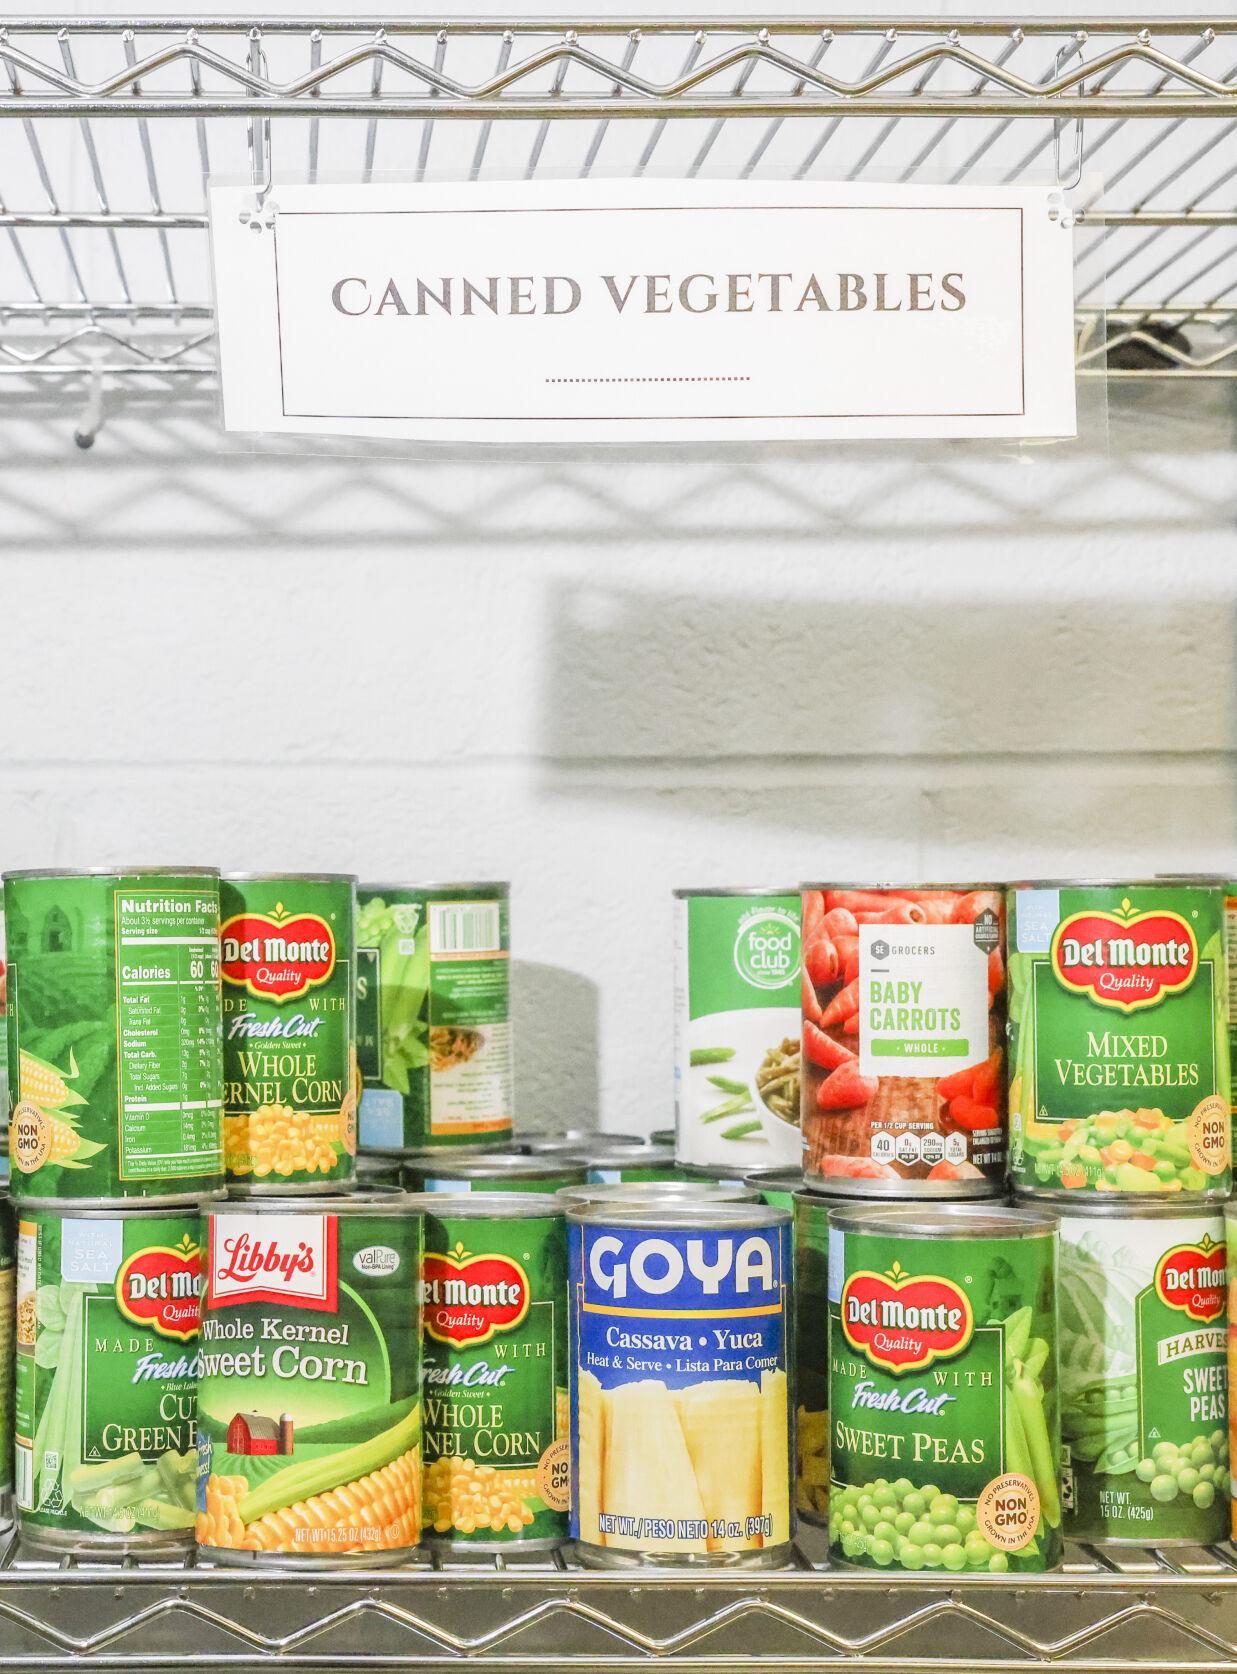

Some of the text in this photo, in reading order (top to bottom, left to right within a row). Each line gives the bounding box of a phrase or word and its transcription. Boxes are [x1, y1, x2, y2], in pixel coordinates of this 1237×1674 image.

[331, 272, 967, 316] CANNED VEGETABLES
[122, 898, 218, 914] Nutrition Facts
[984, 914, 992, 926] NO
[1024, 921, 1048, 931] SEA
[121, 927, 145, 936] Serving
[224, 938, 262, 962] Del
[264, 938, 330, 962] Monte
[748, 932, 791, 952] food
[875, 945, 936, 956] SE GROCERS
[750, 950, 790, 969] club
[1062, 938, 1190, 966] Del Monte
[122, 960, 204, 980] Calories 60
[256, 967, 302, 984] Quality
[1100, 972, 1154, 992] Quality
[122, 996, 150, 1004] Total Fat
[870, 981, 922, 1004] BABY
[309, 998, 346, 1011] WITH
[228, 1012, 326, 1040] Fresh Cut
[870, 1008, 961, 1032] CARROTS
[124, 1028, 158, 1037] Cholesterol
[123, 1040, 146, 1048] Sodium
[254, 1041, 302, 1050] Golden Sweet
[904, 1043, 938, 1054] WHOLE
[1086, 1032, 1168, 1058] MIXED
[140, 1050, 157, 1058] Carb.
[238, 1051, 317, 1078] WHOLE
[1054, 1059, 1200, 1086] VEGETABLES
[145, 1083, 162, 1091] Added
[223, 1077, 342, 1104] ERNEL CORN
[125, 1112, 144, 1120] Vitamin
[1194, 1116, 1202, 1128] NO
[18, 1124, 38, 1136] NON
[124, 1124, 146, 1132] Calcium
[908, 1122, 934, 1130] SERVING
[1202, 1122, 1225, 1134] NON
[18, 1138, 38, 1150] GMO
[125, 1146, 152, 1154] Potassium
[876, 1140, 890, 1152] 40
[952, 1138, 960, 1146] 5g
[1202, 1136, 1225, 1149] GMO
[1194, 1142, 1212, 1167] GROWN
[74, 1249, 108, 1260] SEA
[218, 1233, 314, 1282] Libby's
[358, 1250, 396, 1264] valPure
[70, 1262, 112, 1273] SALT
[590, 1236, 773, 1298] GOYA
[130, 1272, 166, 1300] Del
[1165, 1268, 1194, 1290] Del
[418, 1279, 521, 1306] el Monte
[1192, 1294, 1220, 1308] Quality
[163, 1304, 200, 1322] Qualit
[436, 1311, 484, 1330] Quality
[848, 1296, 962, 1332] Del Monte
[203, 1318, 349, 1346] Whole Kernel
[606, 1326, 763, 1350] Cassava Yuca
[96, 1338, 154, 1352] MADE
[494, 1342, 546, 1358] WITH
[874, 1332, 922, 1355] Quality
[1166, 1330, 1228, 1358] HARVES
[132, 1352, 189, 1384] Fresh
[198, 1346, 266, 1379] Sweet
[272, 1346, 368, 1385] Corn
[587, 1352, 778, 1372] Heat & Serve Lista Para Comer
[463, 1361, 516, 1387] Cut
[832, 1358, 993, 1386] MADE WITH
[166, 1382, 182, 1392] Blue
[462, 1390, 485, 1398] Sweet
[852, 1381, 957, 1416] Fresh Cut
[423, 1398, 504, 1428] WHOLE
[1190, 1396, 1226, 1422] PEAS
[102, 1423, 182, 1452] GREEN
[474, 1429, 540, 1456] CORN
[836, 1420, 984, 1464] SWEET PEAS
[544, 1458, 550, 1470] NO
[552, 1462, 568, 1476] NO
[552, 1476, 568, 1488] GM
[544, 1484, 560, 1504] GROWN
[984, 1480, 1034, 1506] NO PRESERVATIVES
[1099, 1490, 1132, 1505] NET WT.
[995, 1497, 1026, 1512] NON
[1100, 1505, 1154, 1521] 15 OZ. (425g)
[600, 1512, 617, 1533] NET
[644, 1518, 674, 1539] PESO
[678, 1518, 708, 1540] NETO
[711, 1519, 726, 1538] 14
[728, 1521, 744, 1538] oz.
[745, 1514, 772, 1540] (397g)
[994, 1512, 1027, 1526] GMO
[296, 1527, 381, 1542] NET 15.25 OZ (432g)
[984, 1520, 1006, 1544] GROWN
